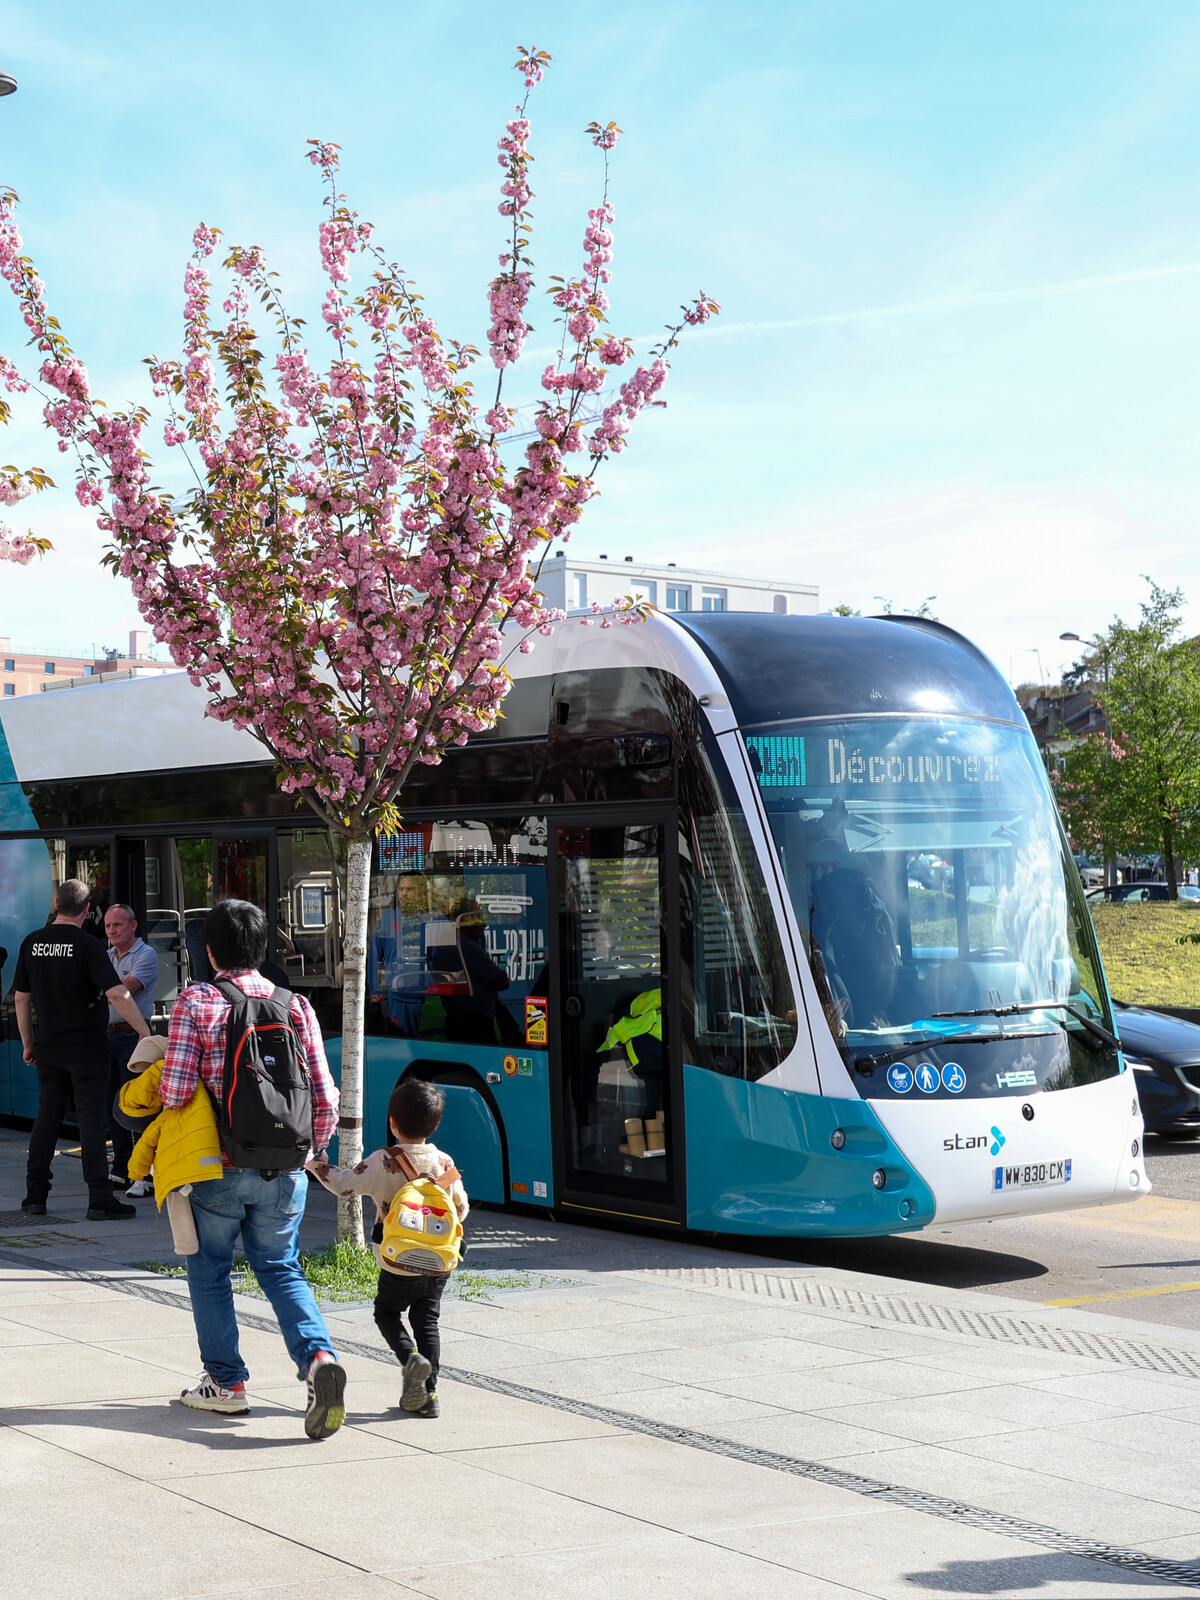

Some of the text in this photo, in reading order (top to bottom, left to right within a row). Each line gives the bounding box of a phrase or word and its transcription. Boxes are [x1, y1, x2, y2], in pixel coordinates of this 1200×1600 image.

[751, 738, 1000, 783] tan Découvrez
[31, 942, 74, 957] SECURITE
[996, 1070, 1038, 1089] HESS
[943, 1133, 988, 1152] stan
